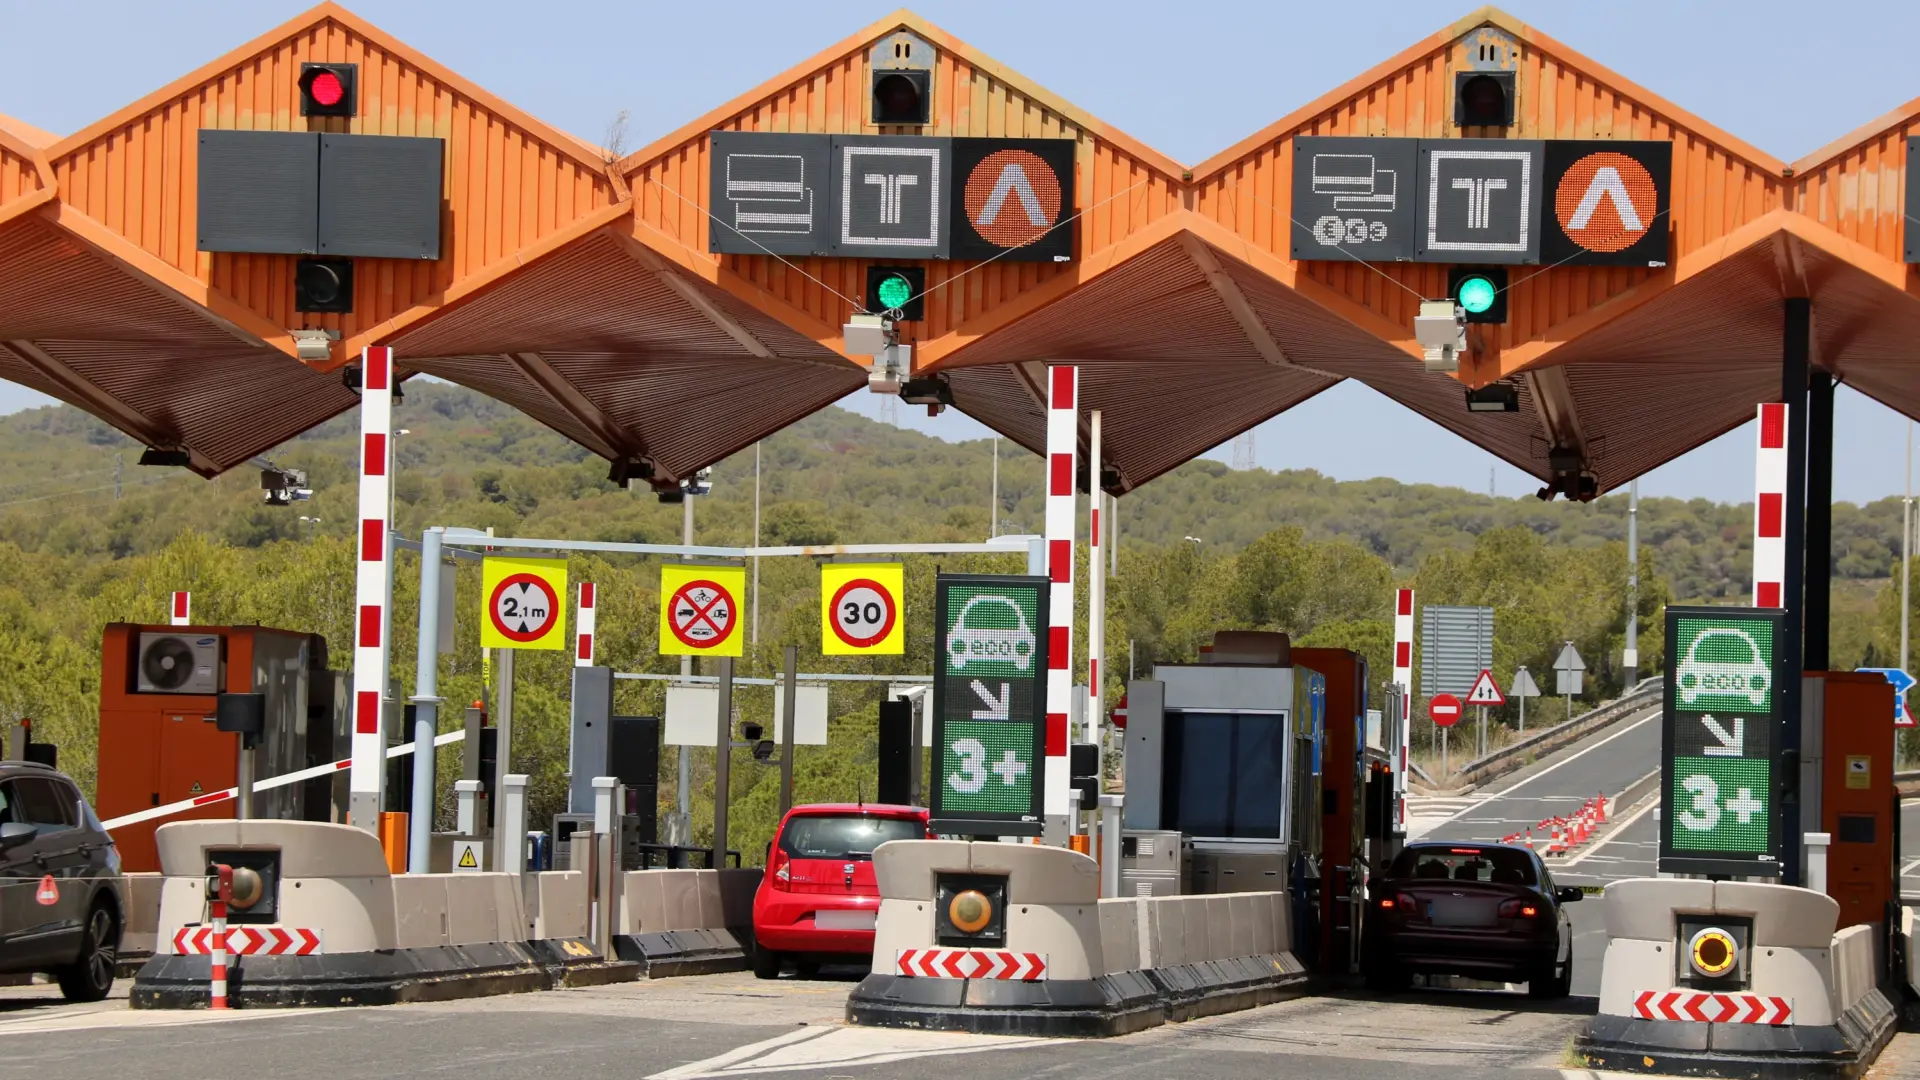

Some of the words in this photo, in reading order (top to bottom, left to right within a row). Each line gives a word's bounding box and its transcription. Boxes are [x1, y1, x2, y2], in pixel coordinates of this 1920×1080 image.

[531, 608, 545, 618] m
[843, 602, 881, 624] 30
[971, 639, 1012, 655] eco
[1702, 673, 1745, 690] eco
[948, 738, 1027, 794] 3+
[1678, 774, 1763, 832] 3+
